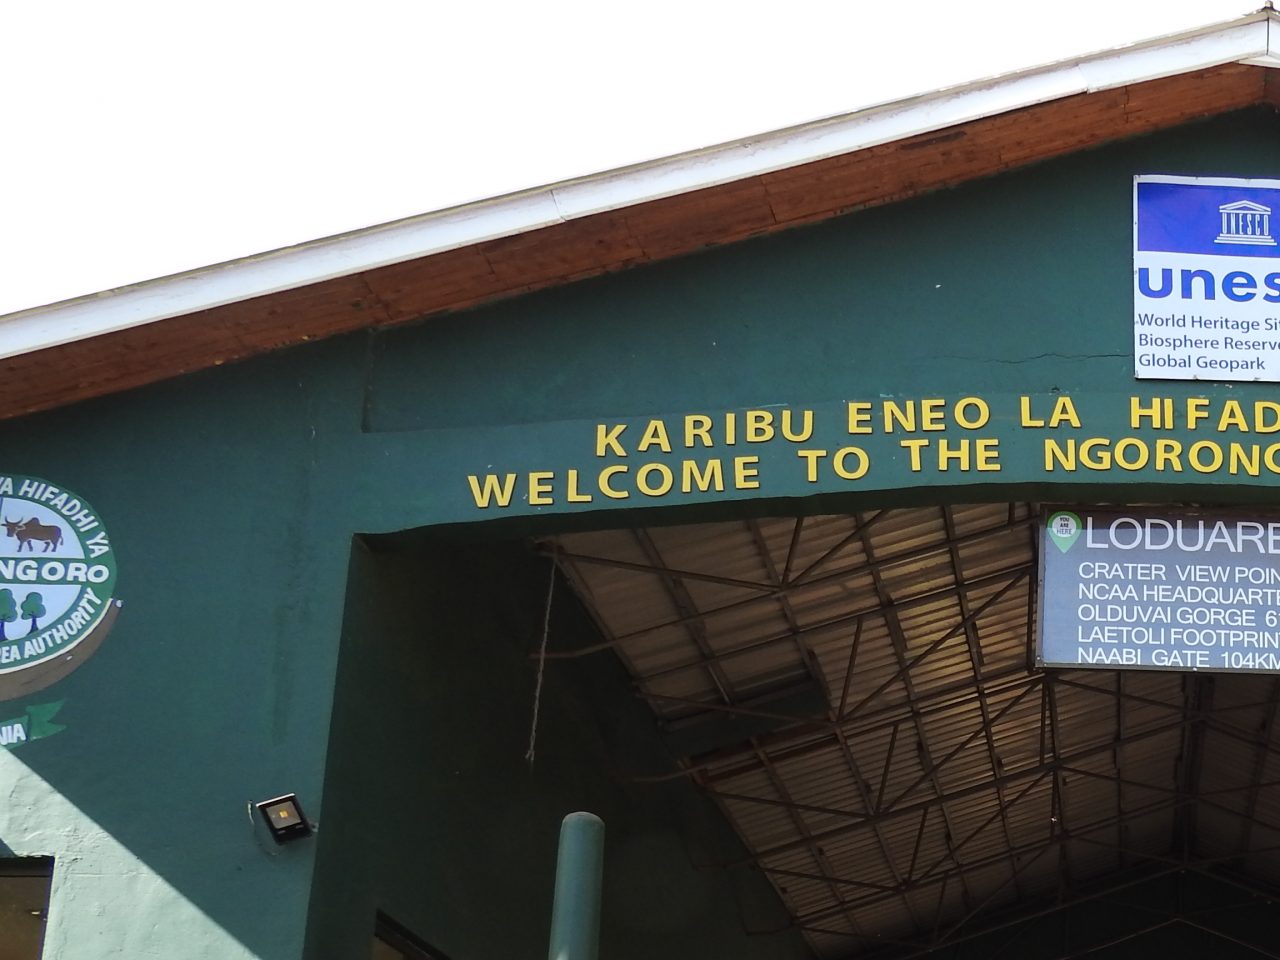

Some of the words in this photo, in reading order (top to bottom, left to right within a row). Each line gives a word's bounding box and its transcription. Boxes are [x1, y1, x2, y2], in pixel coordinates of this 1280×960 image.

[1221, 211, 1270, 237] UNESCO
[1138, 313, 1186, 329] World
[1191, 316, 1260, 333] Heritage
[1139, 334, 1219, 351] Biosphere
[1139, 354, 1191, 369] Global
[1196, 356, 1266, 372] Geopark
[595, 409, 815, 457] KARIBU
[847, 396, 990, 434] ENEO
[1020, 396, 1082, 429] LA
[467, 455, 761, 508] WELCOME
[798, 446, 870, 482] TO
[900, 438, 1001, 472] THE
[18, 479, 100, 532] HIFADHI
[86, 531, 110, 559] YA
[1078, 562, 1166, 582] CRATER
[1176, 565, 1230, 583] VIEW
[1078, 583, 1138, 602] NCAA
[0, 644, 21, 664] EA
[24, 587, 102, 659] AUTHORITY
[1078, 604, 1171, 624] OLDUVAI
[1176, 607, 1255, 627] GORGE
[1078, 626, 1165, 645] LAETOLI
[1078, 648, 1141, 667] NAABI
[1152, 650, 1210, 669] GATE
